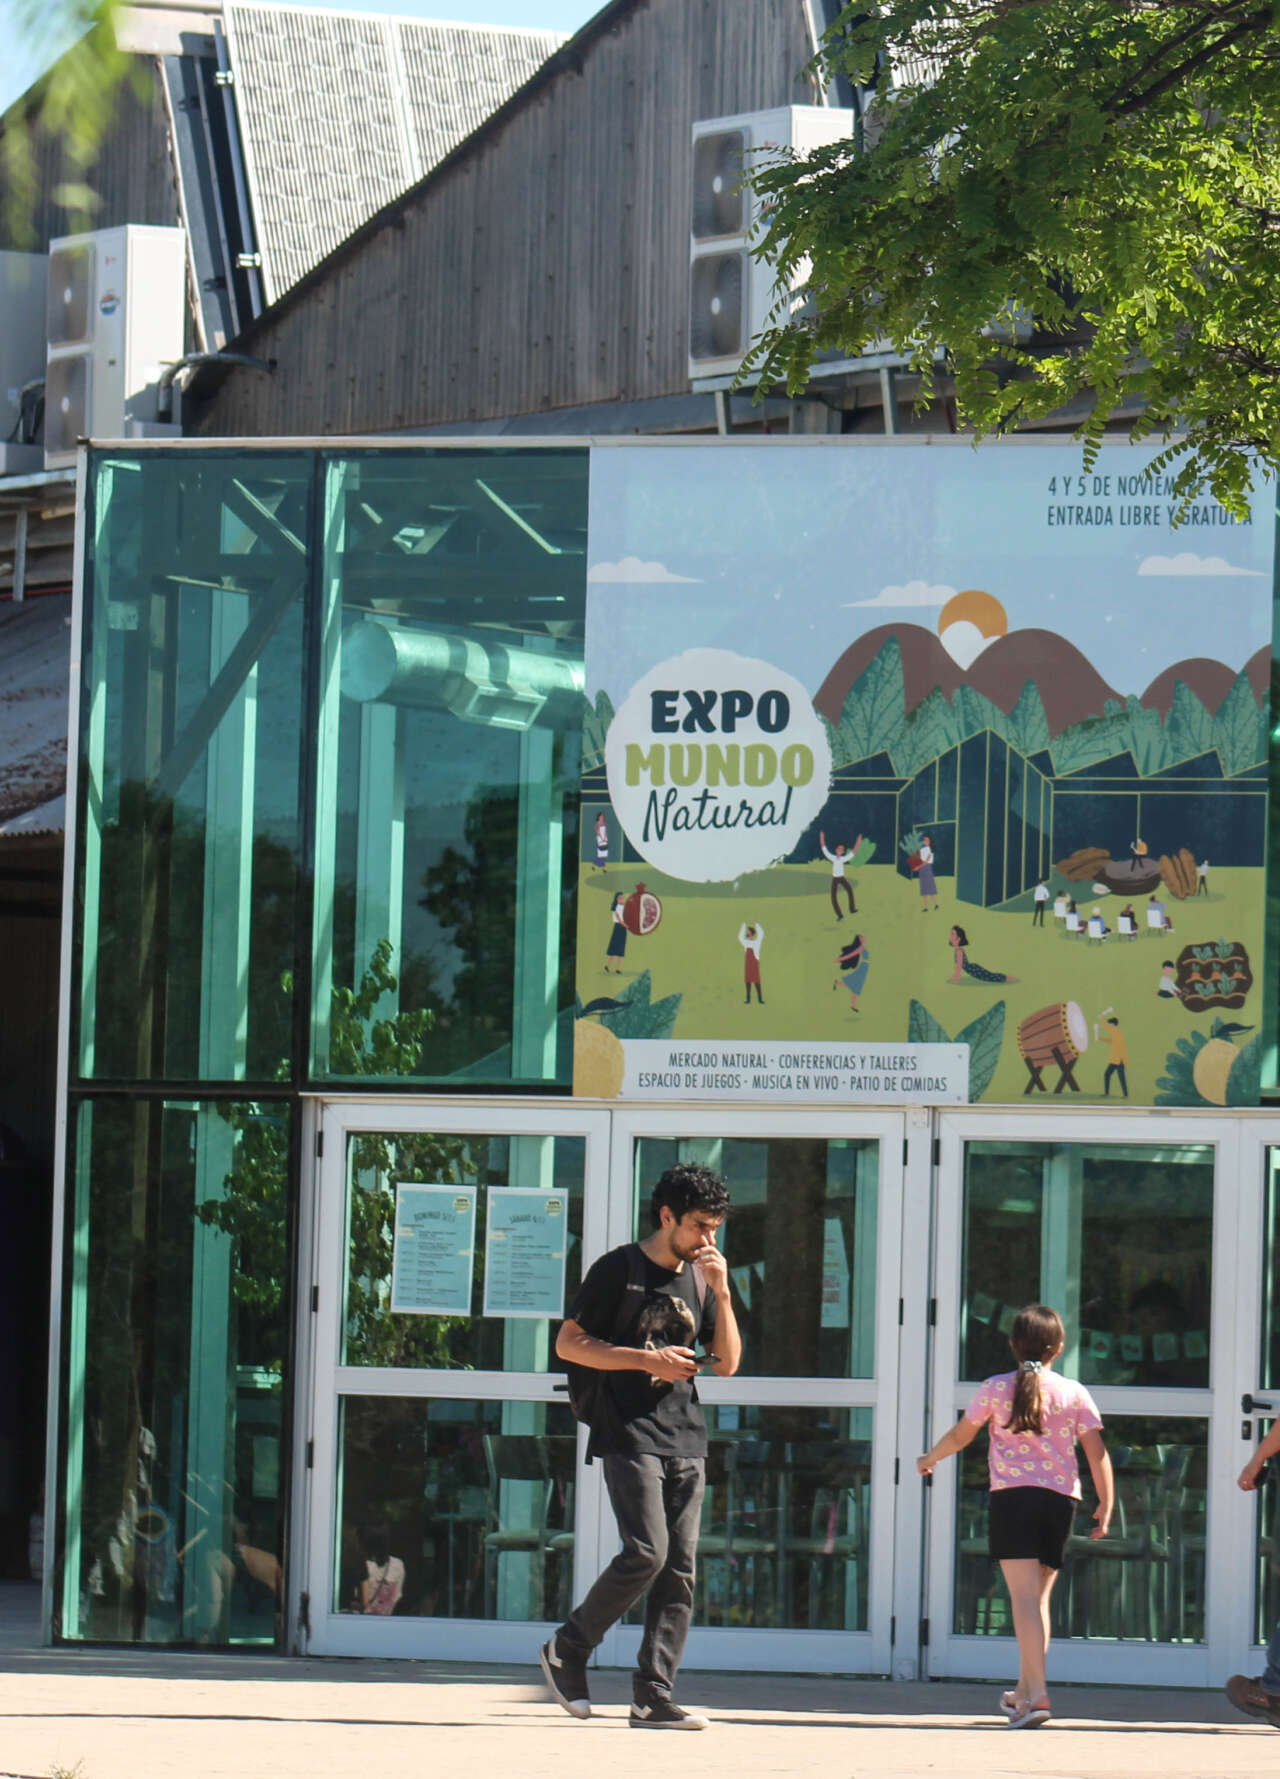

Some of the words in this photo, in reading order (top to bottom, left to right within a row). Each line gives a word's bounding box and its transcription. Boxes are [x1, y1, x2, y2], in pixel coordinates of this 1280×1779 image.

[1048, 476, 1056, 496] 4
[1062, 476, 1072, 496] Y
[1078, 476, 1086, 496] 5
[1093, 476, 1110, 496] DE
[1047, 505, 1113, 525] ENTRADA
[1120, 505, 1160, 525] LIBRE
[1166, 505, 1176, 525] Y
[650, 689, 790, 733] EXPO
[625, 743, 815, 787] MUNDO
[642, 785, 793, 842] Natural
[668, 1052, 718, 1068] MERCADO
[722, 1053, 767, 1068] NATURAL
[779, 1054, 855, 1069] CONFERENCIAS
[860, 1055, 867, 1069] Y
[870, 1055, 917, 1071] TALLERES
[638, 1072, 681, 1088] ESPACIO
[685, 1073, 697, 1088] DE
[701, 1074, 741, 1089] JUEGOS
[752, 1074, 792, 1089] MUSICA
[796, 1075, 809, 1089] EN
[814, 1075, 838, 1090] VIVO
[850, 1076, 880, 1091] PATIO
[884, 1076, 896, 1091] DE
[901, 1077, 947, 1092] COMIDAS
